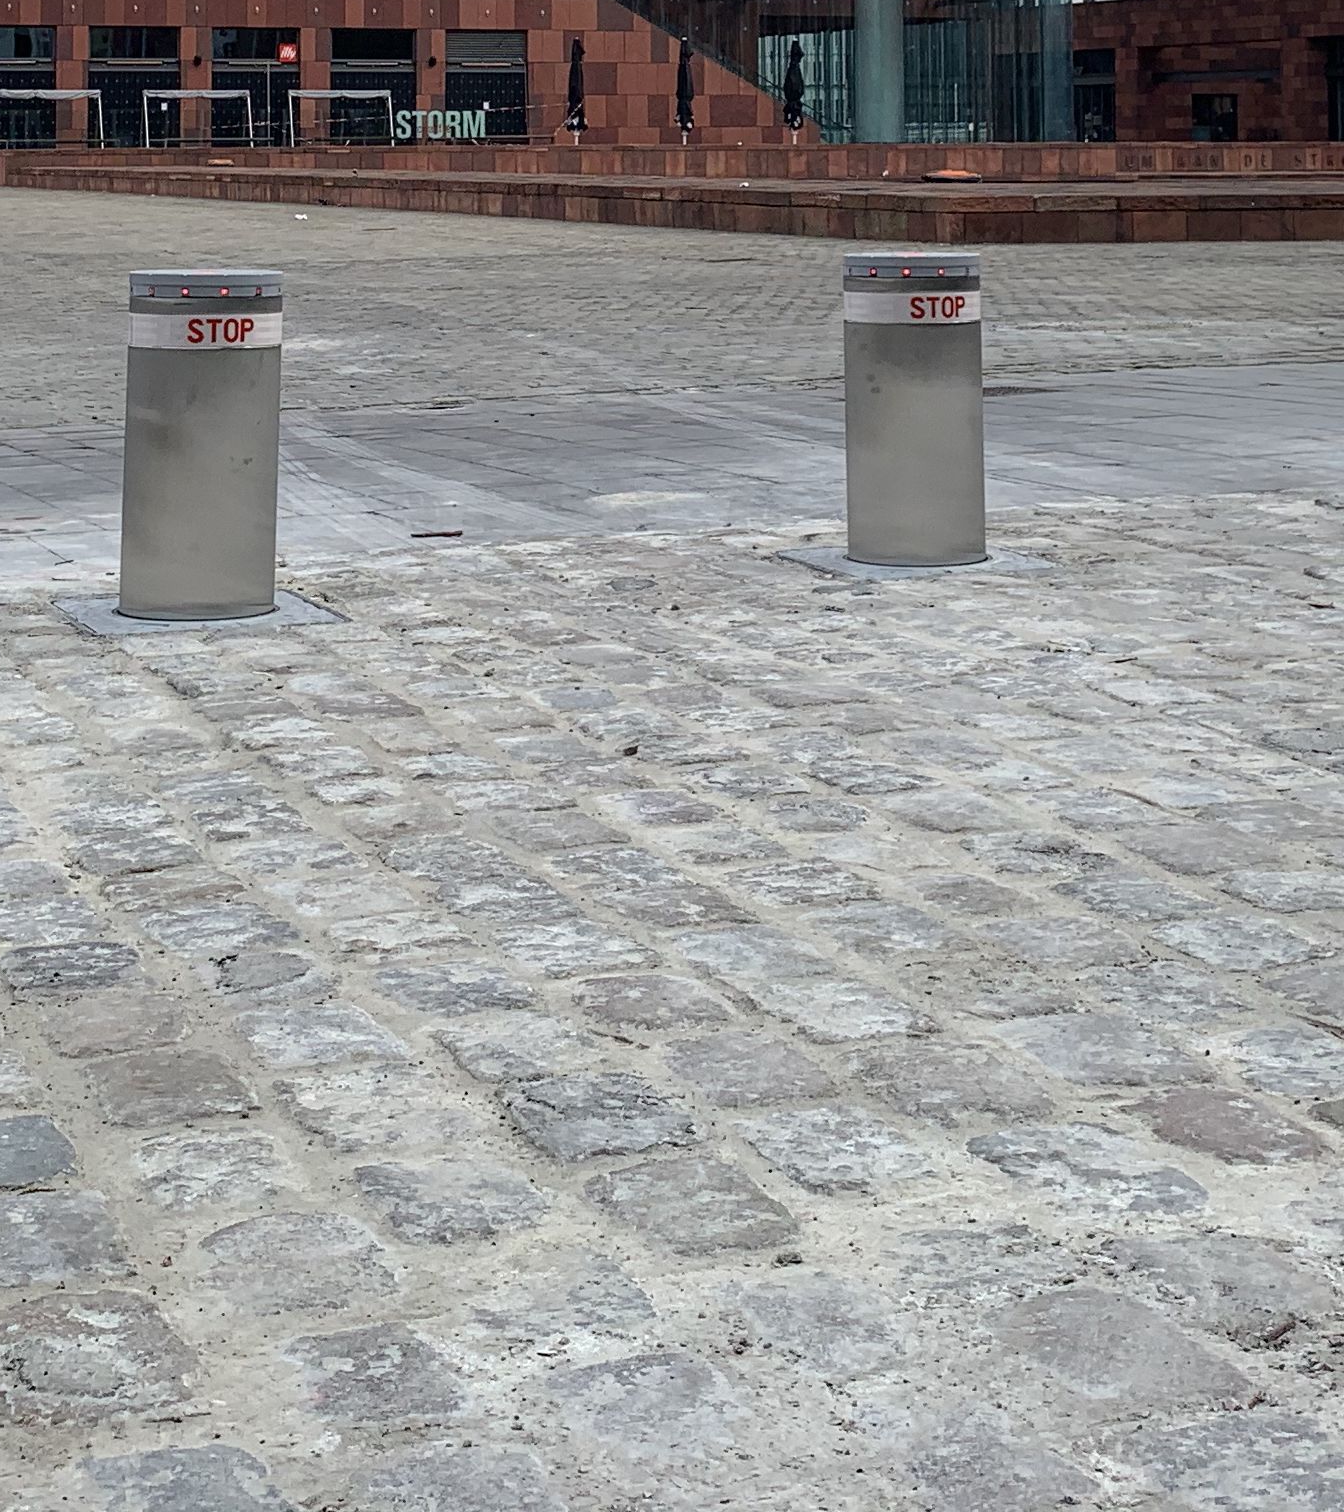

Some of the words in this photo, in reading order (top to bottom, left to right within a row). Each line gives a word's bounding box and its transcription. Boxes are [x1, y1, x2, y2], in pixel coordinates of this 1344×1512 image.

[396, 110, 486, 139] STORM
[910, 295, 965, 319] STOP
[187, 318, 255, 344] STOP
